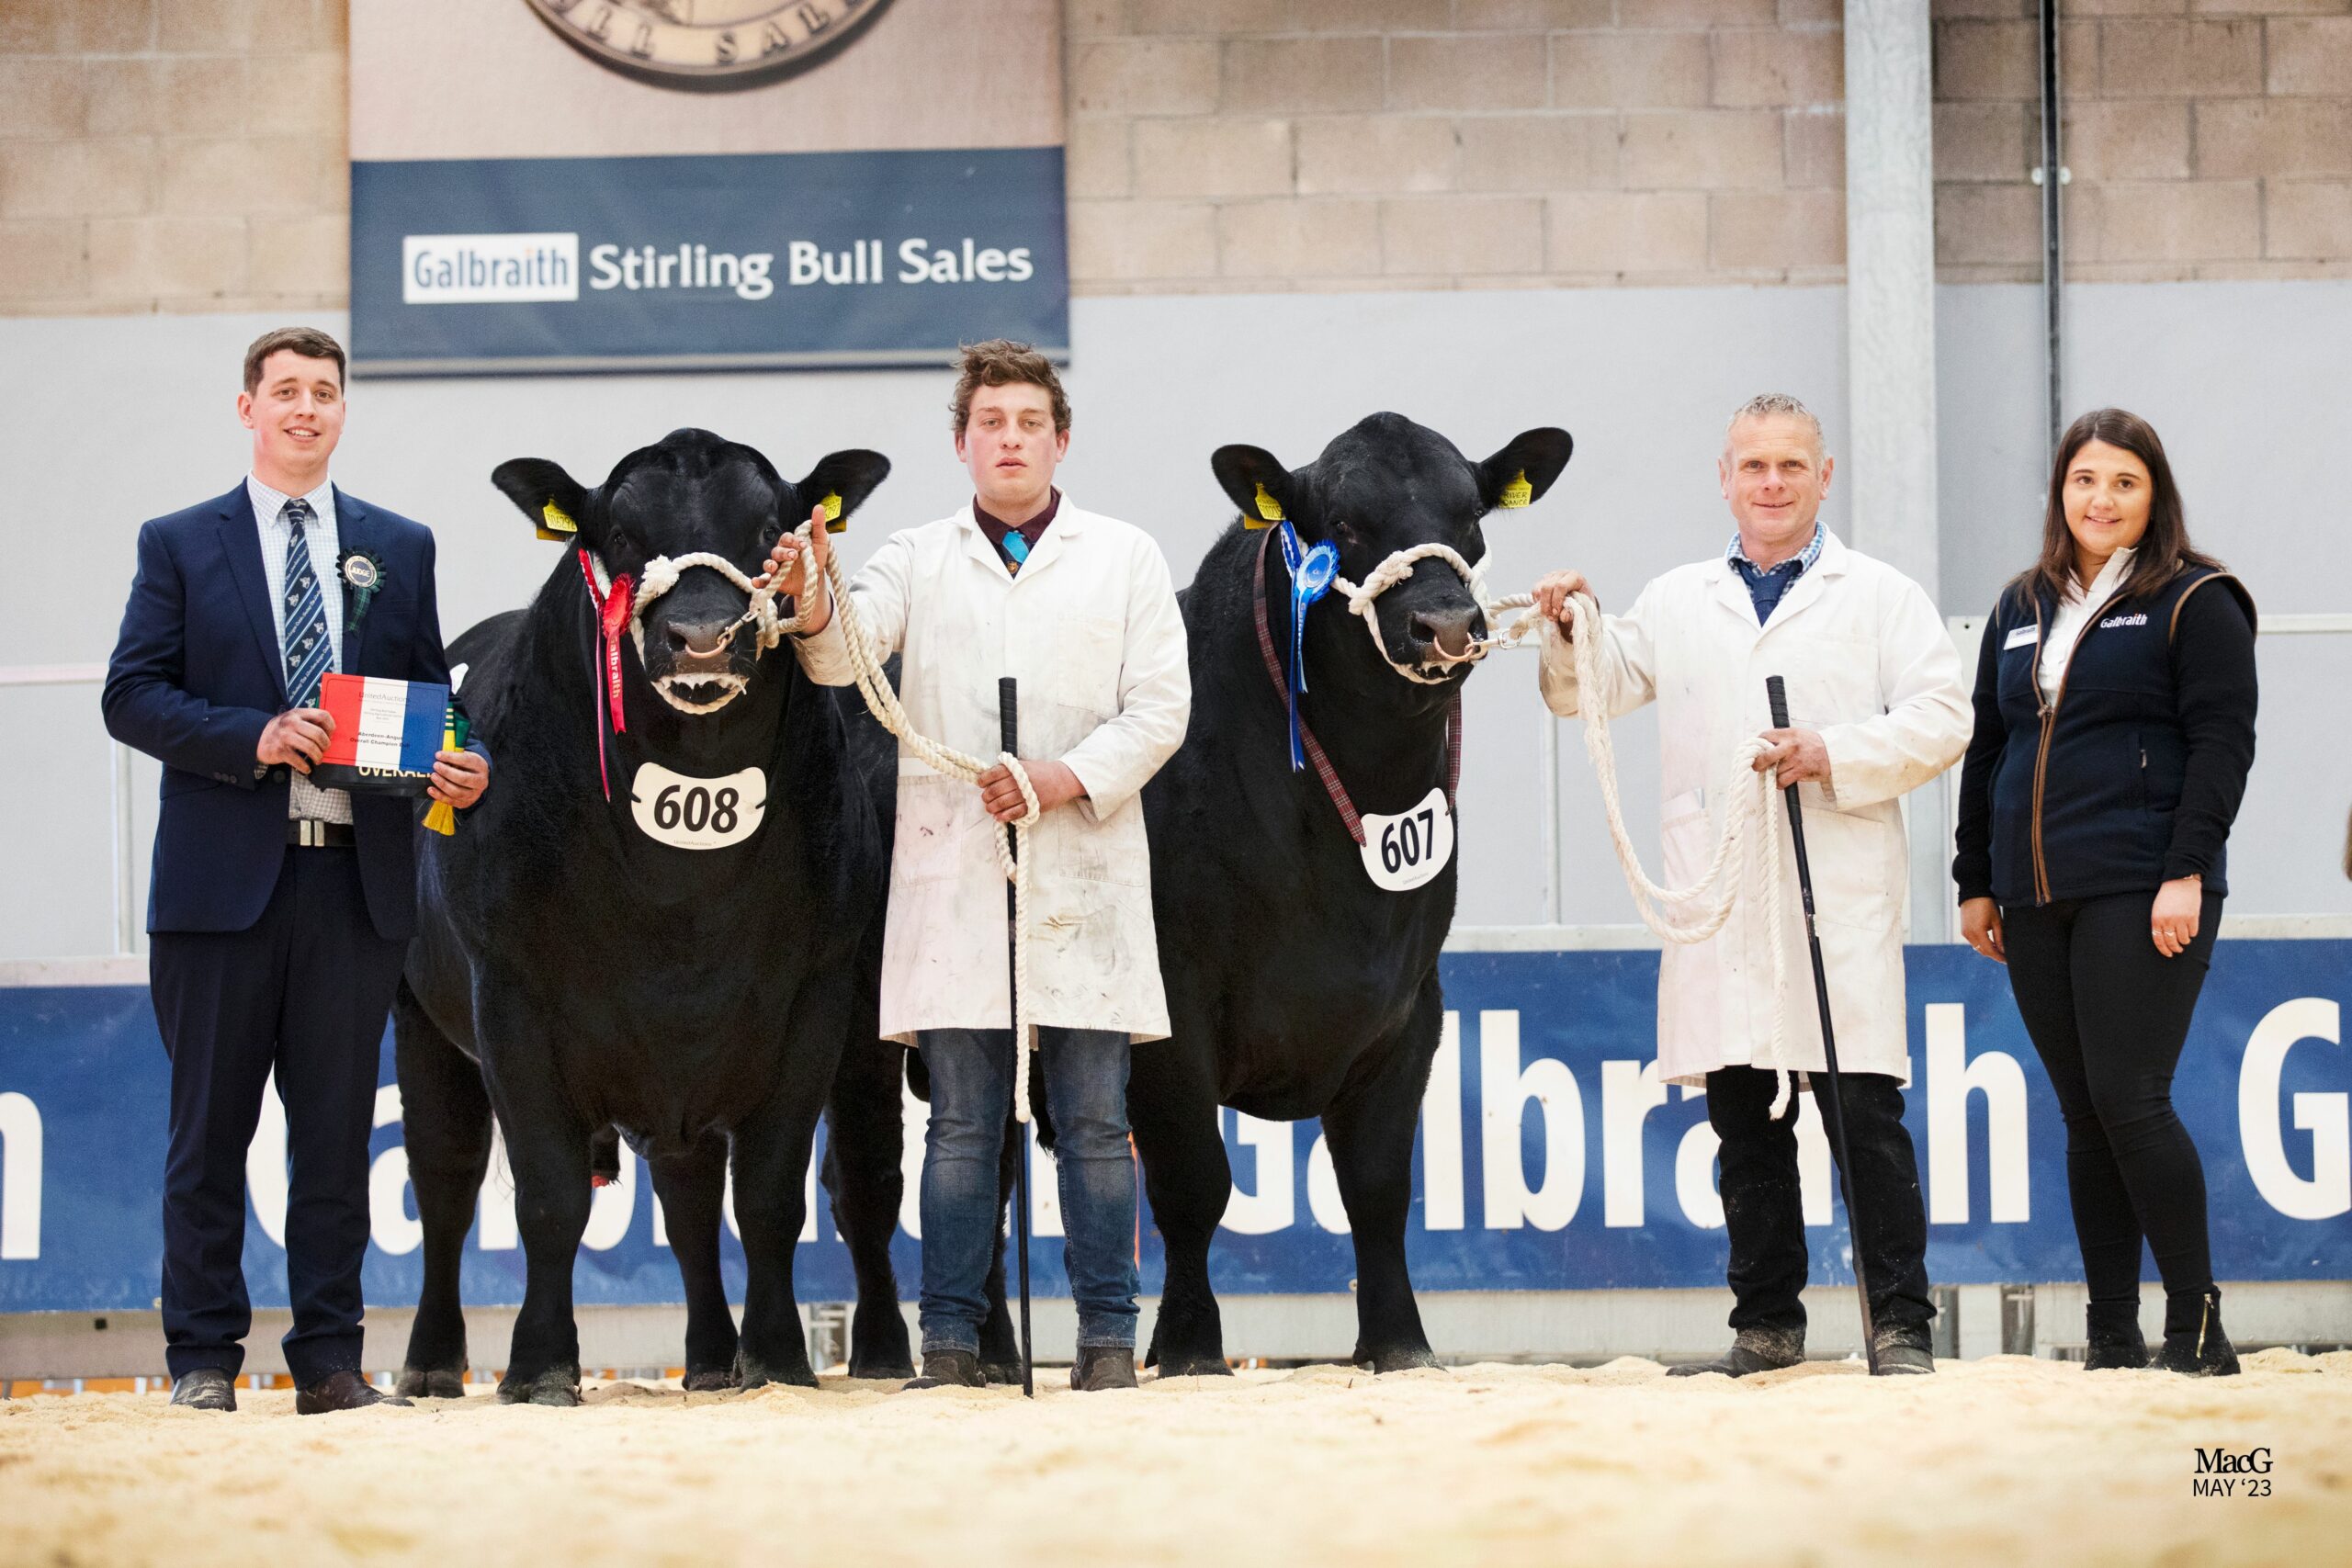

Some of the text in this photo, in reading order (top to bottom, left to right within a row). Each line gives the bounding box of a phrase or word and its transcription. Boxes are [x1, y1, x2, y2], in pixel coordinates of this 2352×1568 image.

[414, 248, 569, 288] Galbraith
[589, 237, 1035, 300] Stirling Bull Sales
[349, 564, 371, 578] JUDGE
[2100, 613, 2148, 628] Galbraith
[653, 784, 740, 834] 608
[1381, 807, 1433, 874] 607
